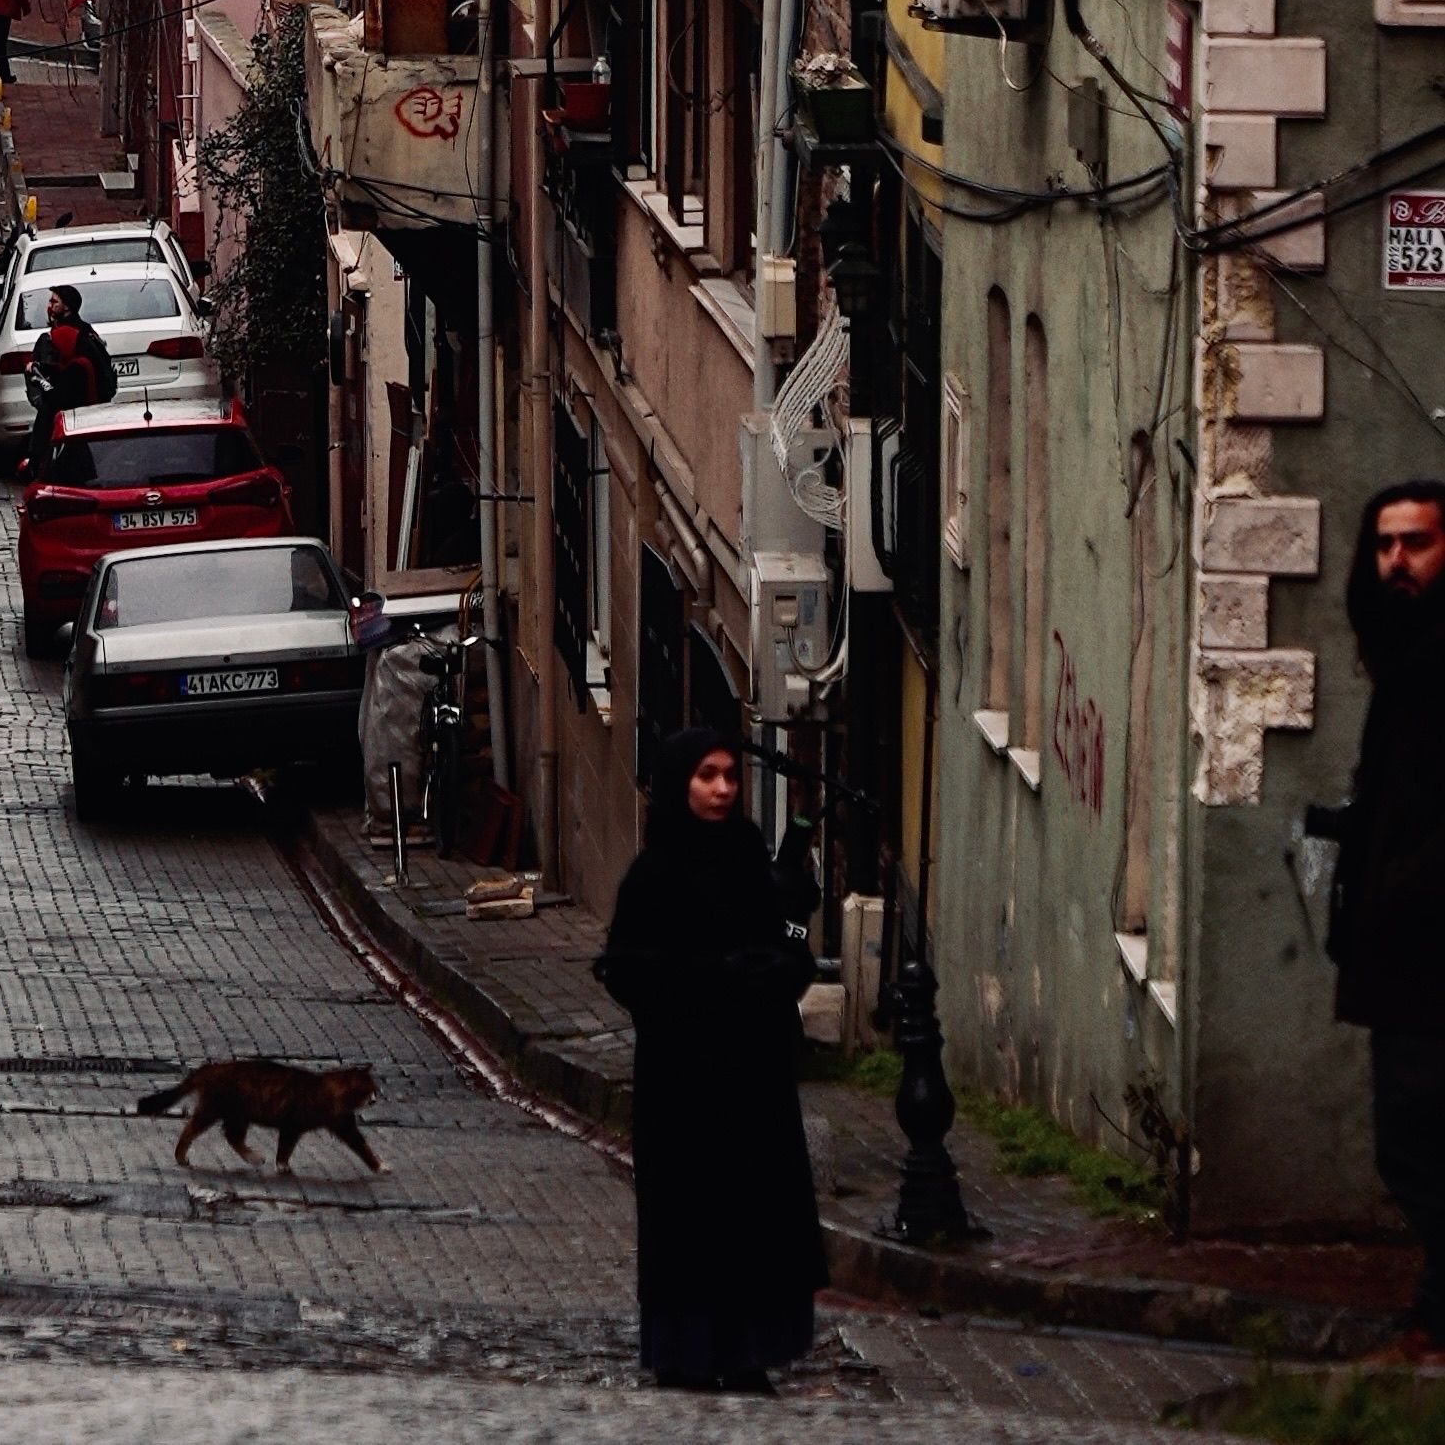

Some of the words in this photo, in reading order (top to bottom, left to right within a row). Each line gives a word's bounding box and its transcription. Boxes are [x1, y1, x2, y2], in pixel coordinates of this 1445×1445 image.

[1401, 246, 1443, 272] 523
[122, 514, 136, 528] 34
[142, 511, 165, 527] BSV
[171, 510, 195, 525] 575
[188, 677, 205, 693] 41
[247, 671, 278, 688] 773
